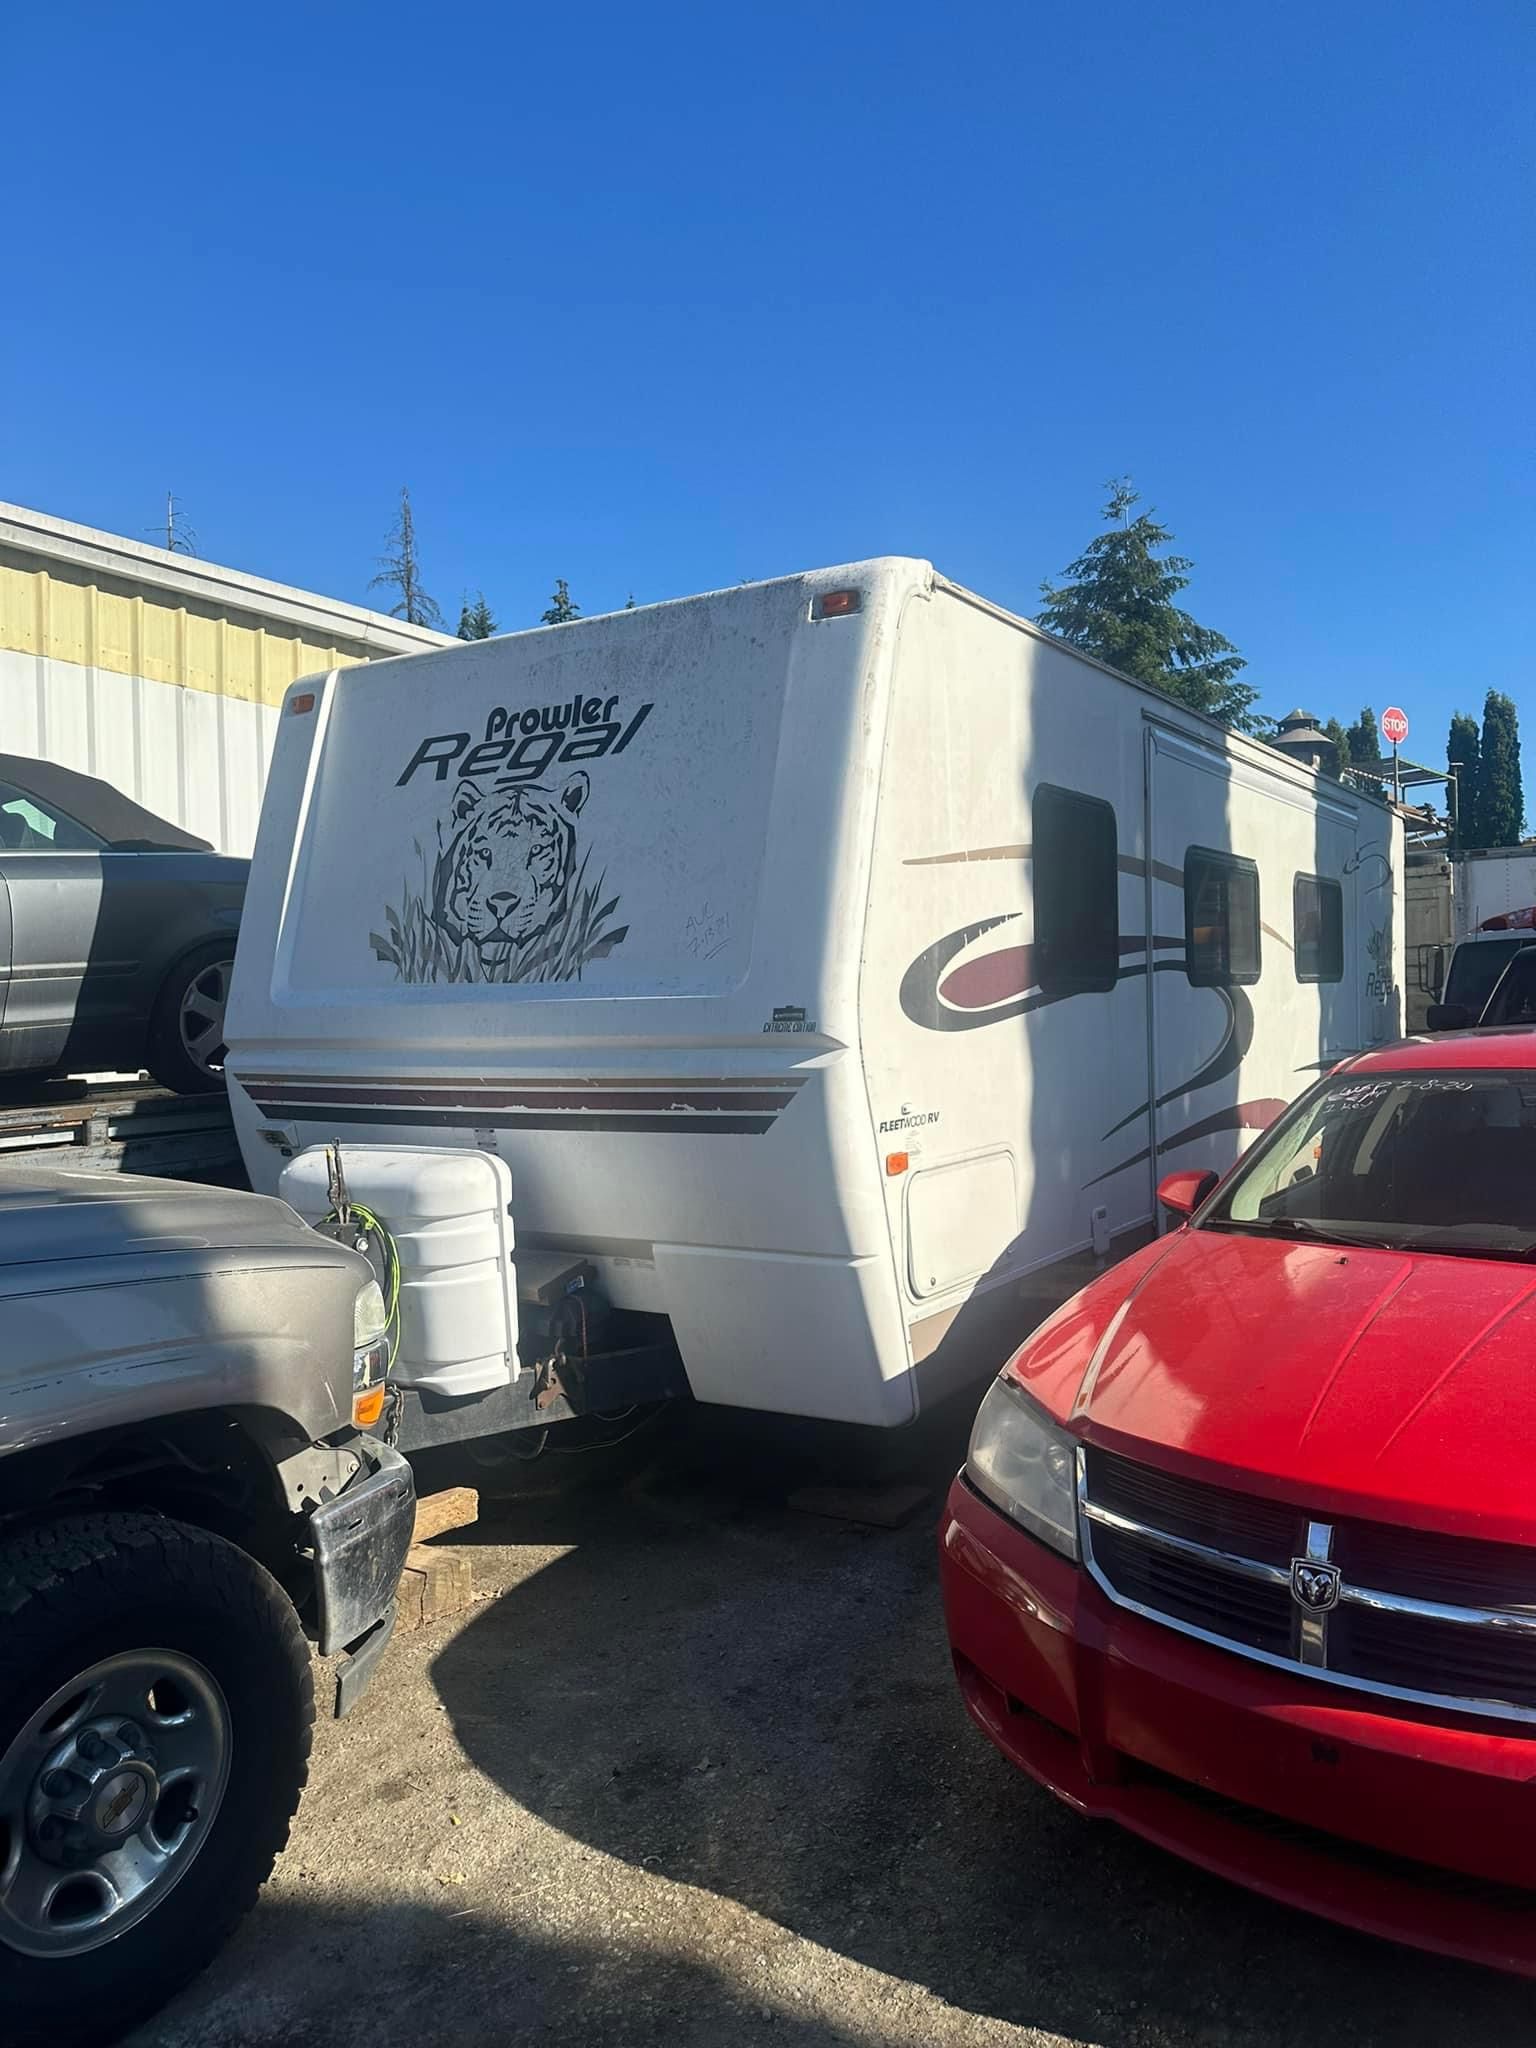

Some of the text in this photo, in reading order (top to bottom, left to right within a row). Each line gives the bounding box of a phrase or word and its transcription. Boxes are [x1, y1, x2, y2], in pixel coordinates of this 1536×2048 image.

[485, 694, 619, 741] Prowler
[1384, 717, 1407, 733] STOP
[395, 703, 654, 787] Regal
[879, 1111, 940, 1134] FLEETWOOD RV
